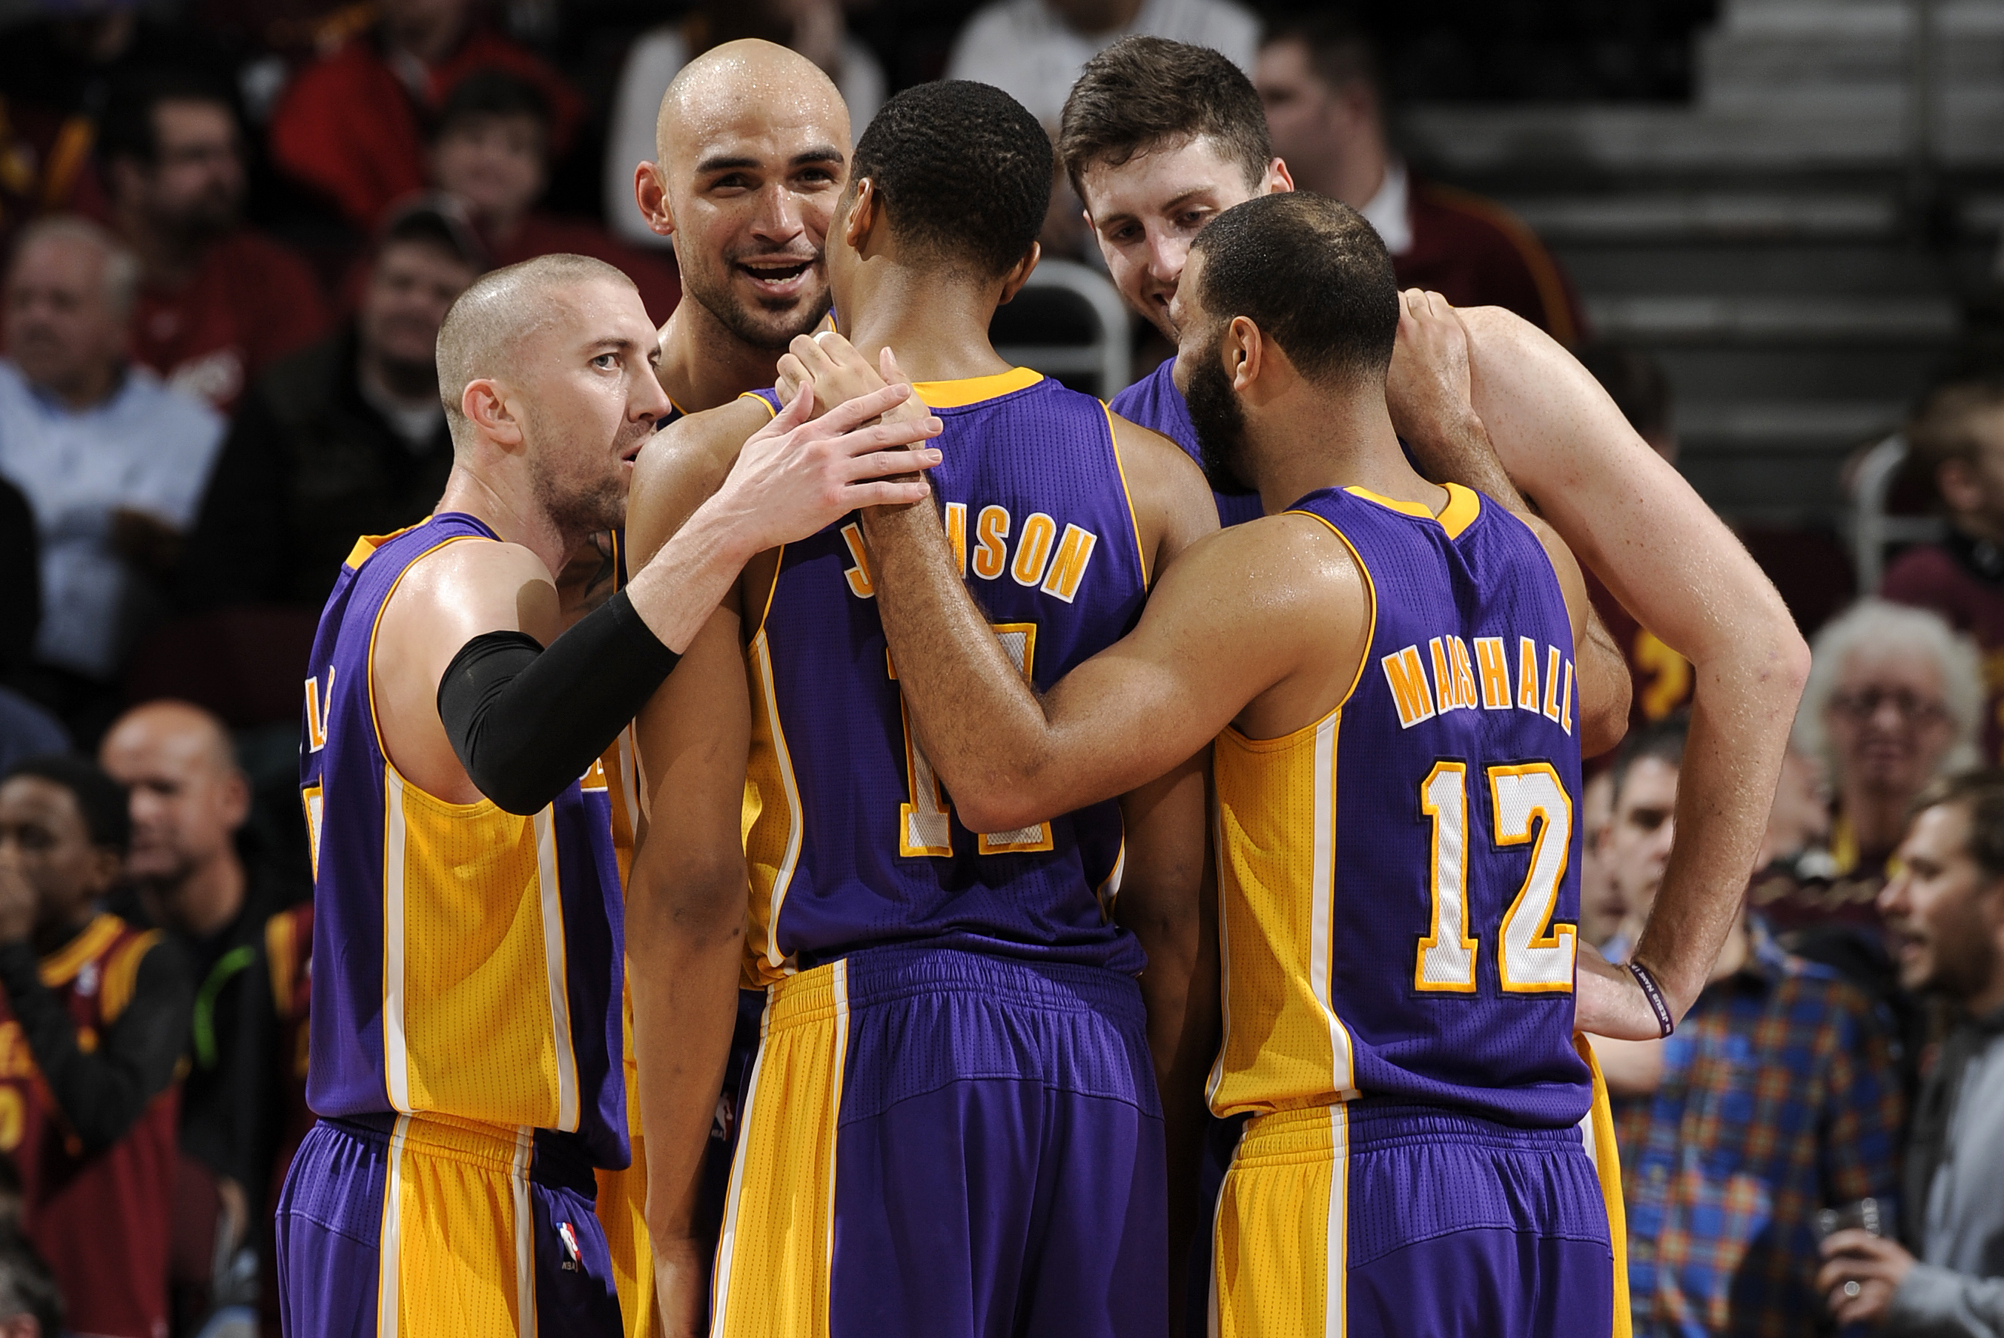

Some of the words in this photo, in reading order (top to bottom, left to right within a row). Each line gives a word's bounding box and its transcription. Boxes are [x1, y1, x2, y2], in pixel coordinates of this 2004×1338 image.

[840, 501, 1098, 604] JNSON
[1415, 761, 1577, 993] 12
[1638, 971, 1655, 993] NAME
[1652, 993, 1669, 1022] JESUS
